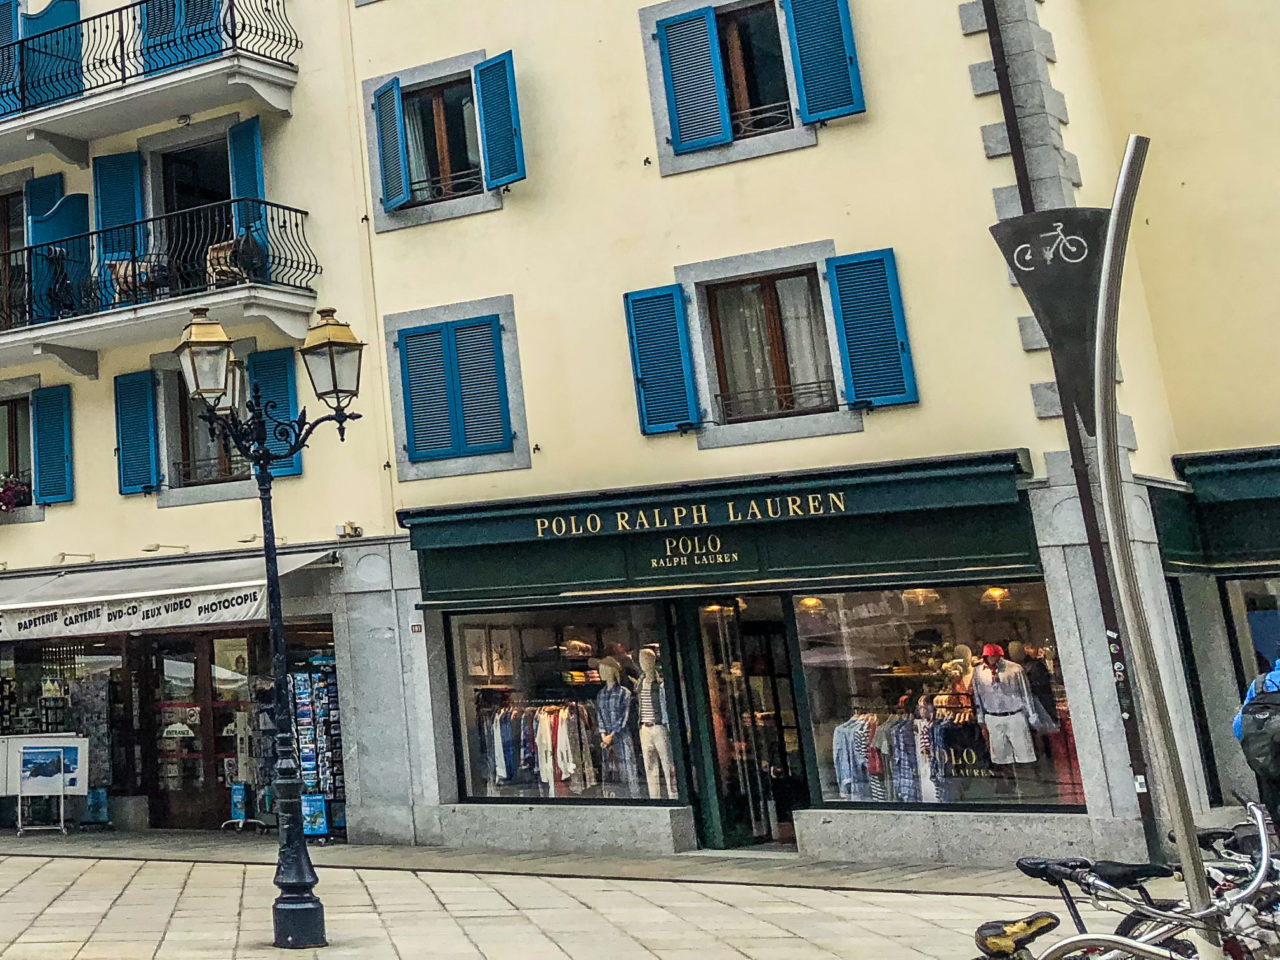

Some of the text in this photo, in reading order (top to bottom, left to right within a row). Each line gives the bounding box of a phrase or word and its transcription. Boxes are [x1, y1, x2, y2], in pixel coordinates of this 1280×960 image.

[536, 492, 847, 537] POLO RALPH LAUREN
[665, 534, 721, 555] POLO
[651, 552, 739, 568] RALPH LAUREN
[107, 605, 138, 622] DVD-CD
[141, 598, 192, 621] JEUX VIDEO
[197, 591, 258, 616] PHOTOCOPIE
[17, 611, 58, 632] PAPETERIE
[63, 608, 101, 627] CARTERIE
[951, 768, 995, 777] LAUREN
